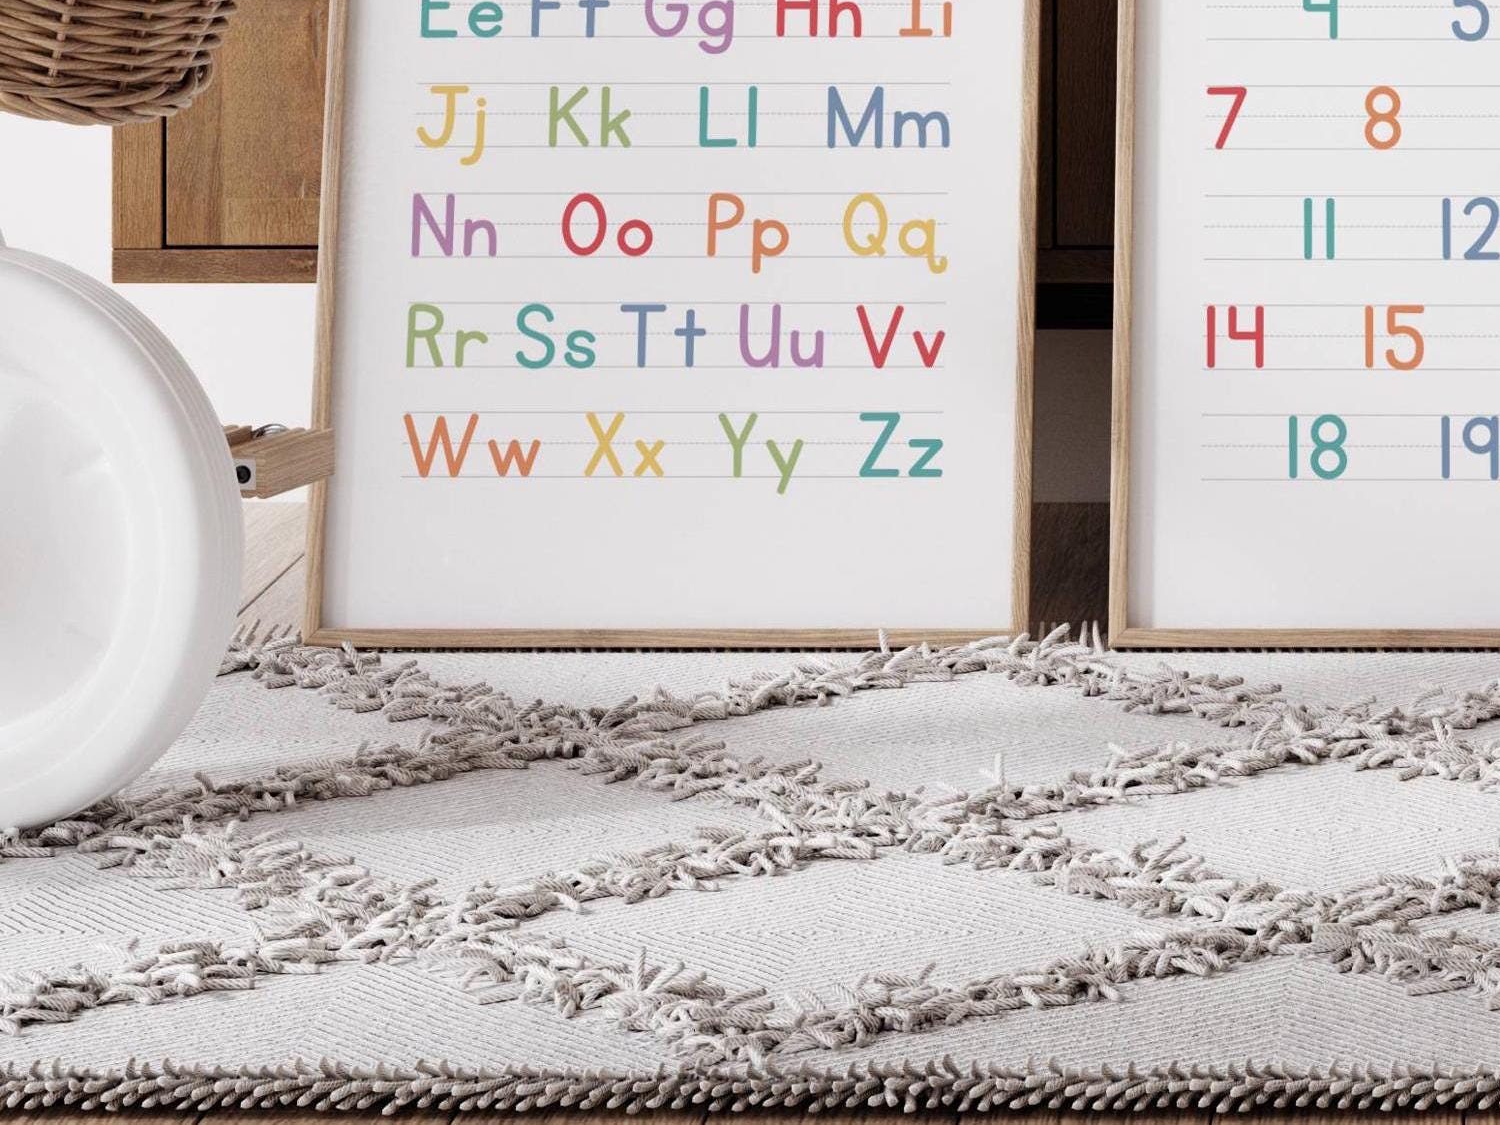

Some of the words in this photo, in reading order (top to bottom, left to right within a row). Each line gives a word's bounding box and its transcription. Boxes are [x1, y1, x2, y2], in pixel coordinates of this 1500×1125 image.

[415, 82, 488, 168] Jj
[548, 86, 631, 149] Kk
[698, 85, 759, 149] Ll
[827, 85, 951, 150] Mm
[1205, 84, 1249, 151] 7
[1363, 83, 1403, 152] 8
[410, 193, 497, 257] Nn
[560, 191, 655, 259] Oo
[704, 190, 791, 277] Pp
[841, 190, 951, 276] Qq
[1302, 196, 1336, 261] 11
[1442, 196, 1500, 262] 12
[406, 302, 488, 369] Rr
[515, 302, 597, 370] Ss
[622, 303, 706, 368] Tt
[739, 303, 825, 369] Uu
[855, 302, 946, 371] Vv
[1204, 303, 1265, 371] 14
[1363, 302, 1425, 373] 15
[402, 411, 542, 481] Ww
[582, 410, 666, 480] Xx
[719, 412, 803, 496] Yy
[858, 411, 945, 479] Zz
[1287, 413, 1349, 481] 18
[1440, 415, 1500, 481] 19
